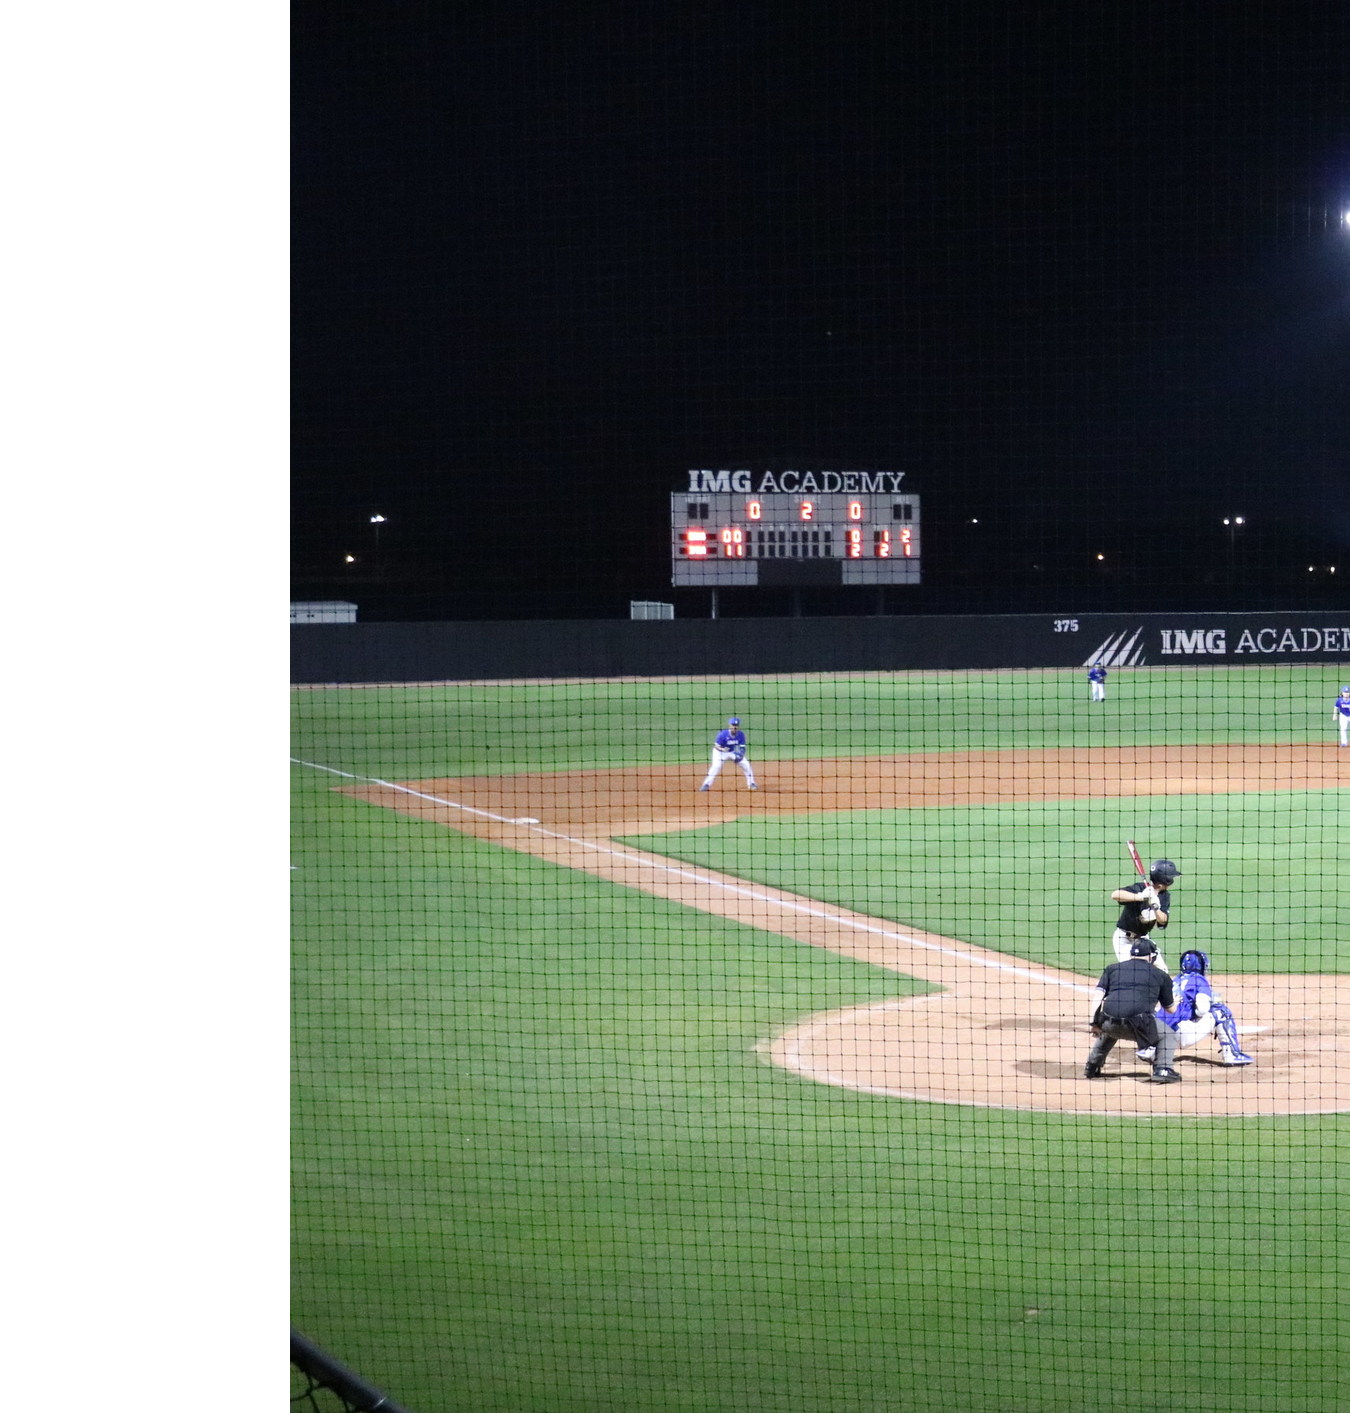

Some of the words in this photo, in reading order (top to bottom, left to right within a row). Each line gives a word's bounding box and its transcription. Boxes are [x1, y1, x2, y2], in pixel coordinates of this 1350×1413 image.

[688, 469, 752, 493] IMG
[757, 470, 906, 493] ACADEMY
[749, 501, 762, 520] 0
[801, 501, 813, 520] 2
[849, 502, 862, 520] 0
[1053, 619, 1080, 633] 375
[1159, 628, 1227, 655] IMG
